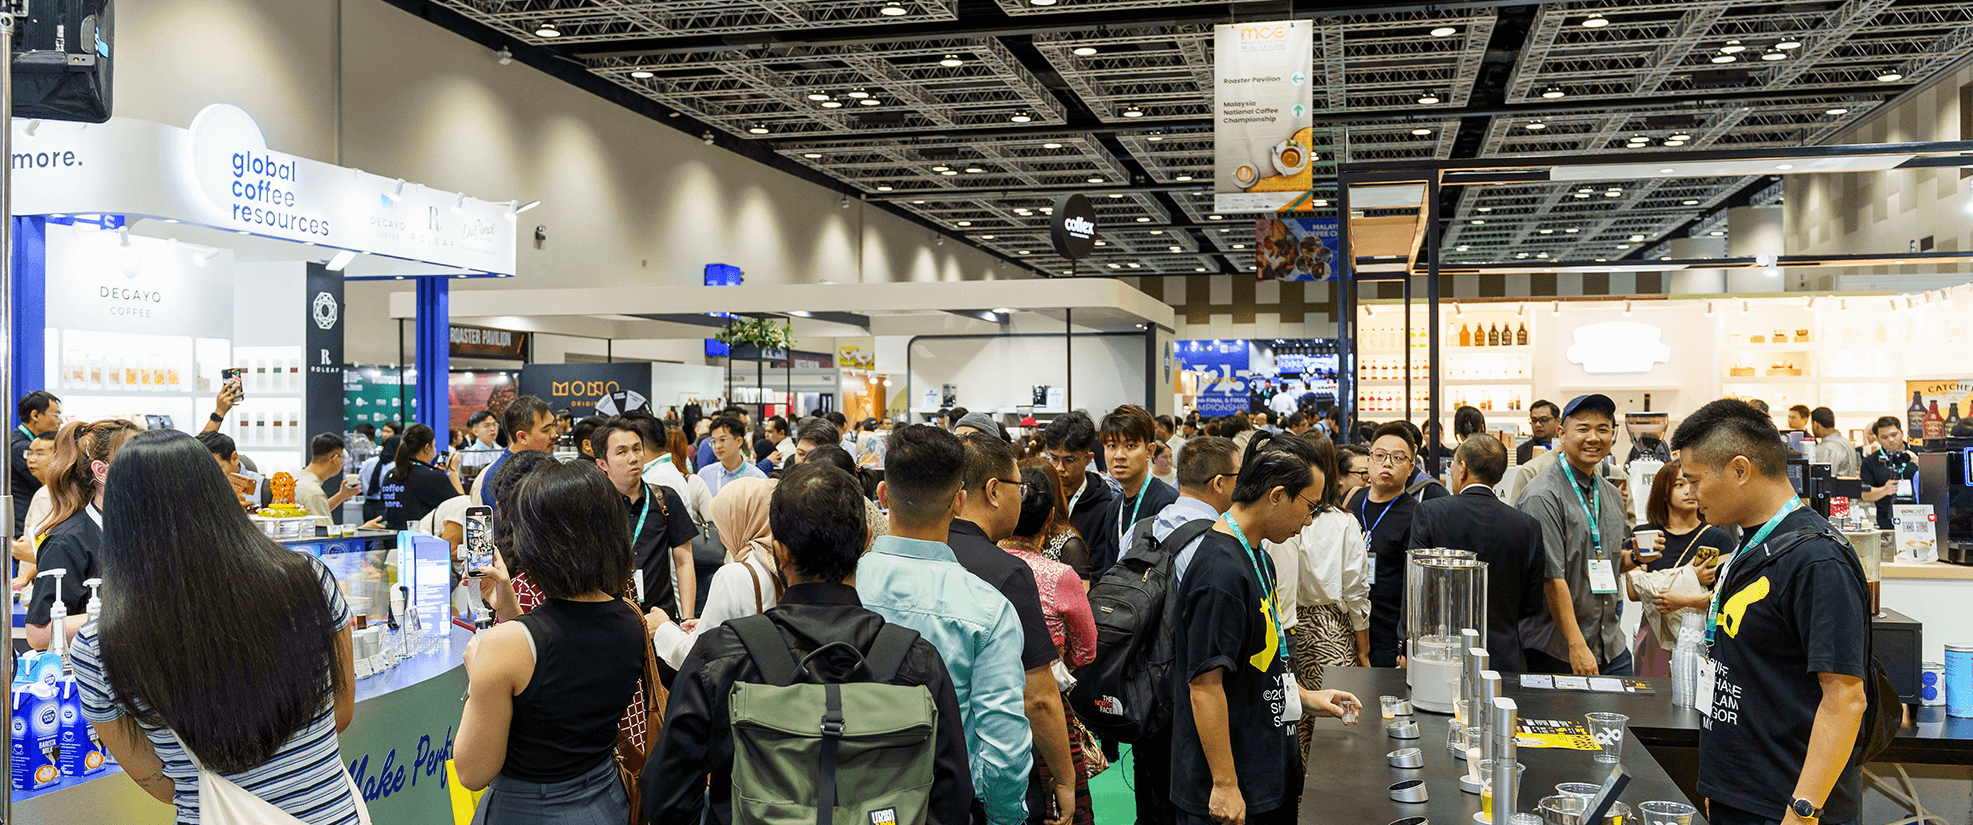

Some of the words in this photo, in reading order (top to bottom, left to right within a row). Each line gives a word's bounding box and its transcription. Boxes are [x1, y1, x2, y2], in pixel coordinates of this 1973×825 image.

[1252, 75, 1281, 83] Pavilion
[1223, 99, 1256, 108] Malaysia
[1223, 108, 1254, 116] National
[1255, 107, 1279, 115] Coffee
[1223, 115, 1277, 124] Championship
[12, 150, 84, 169] more.
[232, 150, 296, 182] global
[232, 180, 295, 207] coffee
[232, 203, 330, 236] resources
[1064, 216, 1094, 236] coffex
[100, 286, 162, 303] DEGAYO
[110, 306, 151, 318] COFFEE
[450, 327, 481, 345] ROASTER
[482, 329, 512, 347] PAVILION
[311, 366, 340, 374] ROLEAF
[552, 380, 620, 396] MONO
[1928, 383, 1973, 393] CATCHE
[1094, 699, 1113, 708] NORTH
[1102, 694, 1113, 703] THE
[1099, 706, 1113, 715] FACE
[348, 748, 406, 804] Make
[411, 725, 453, 790] Perf
